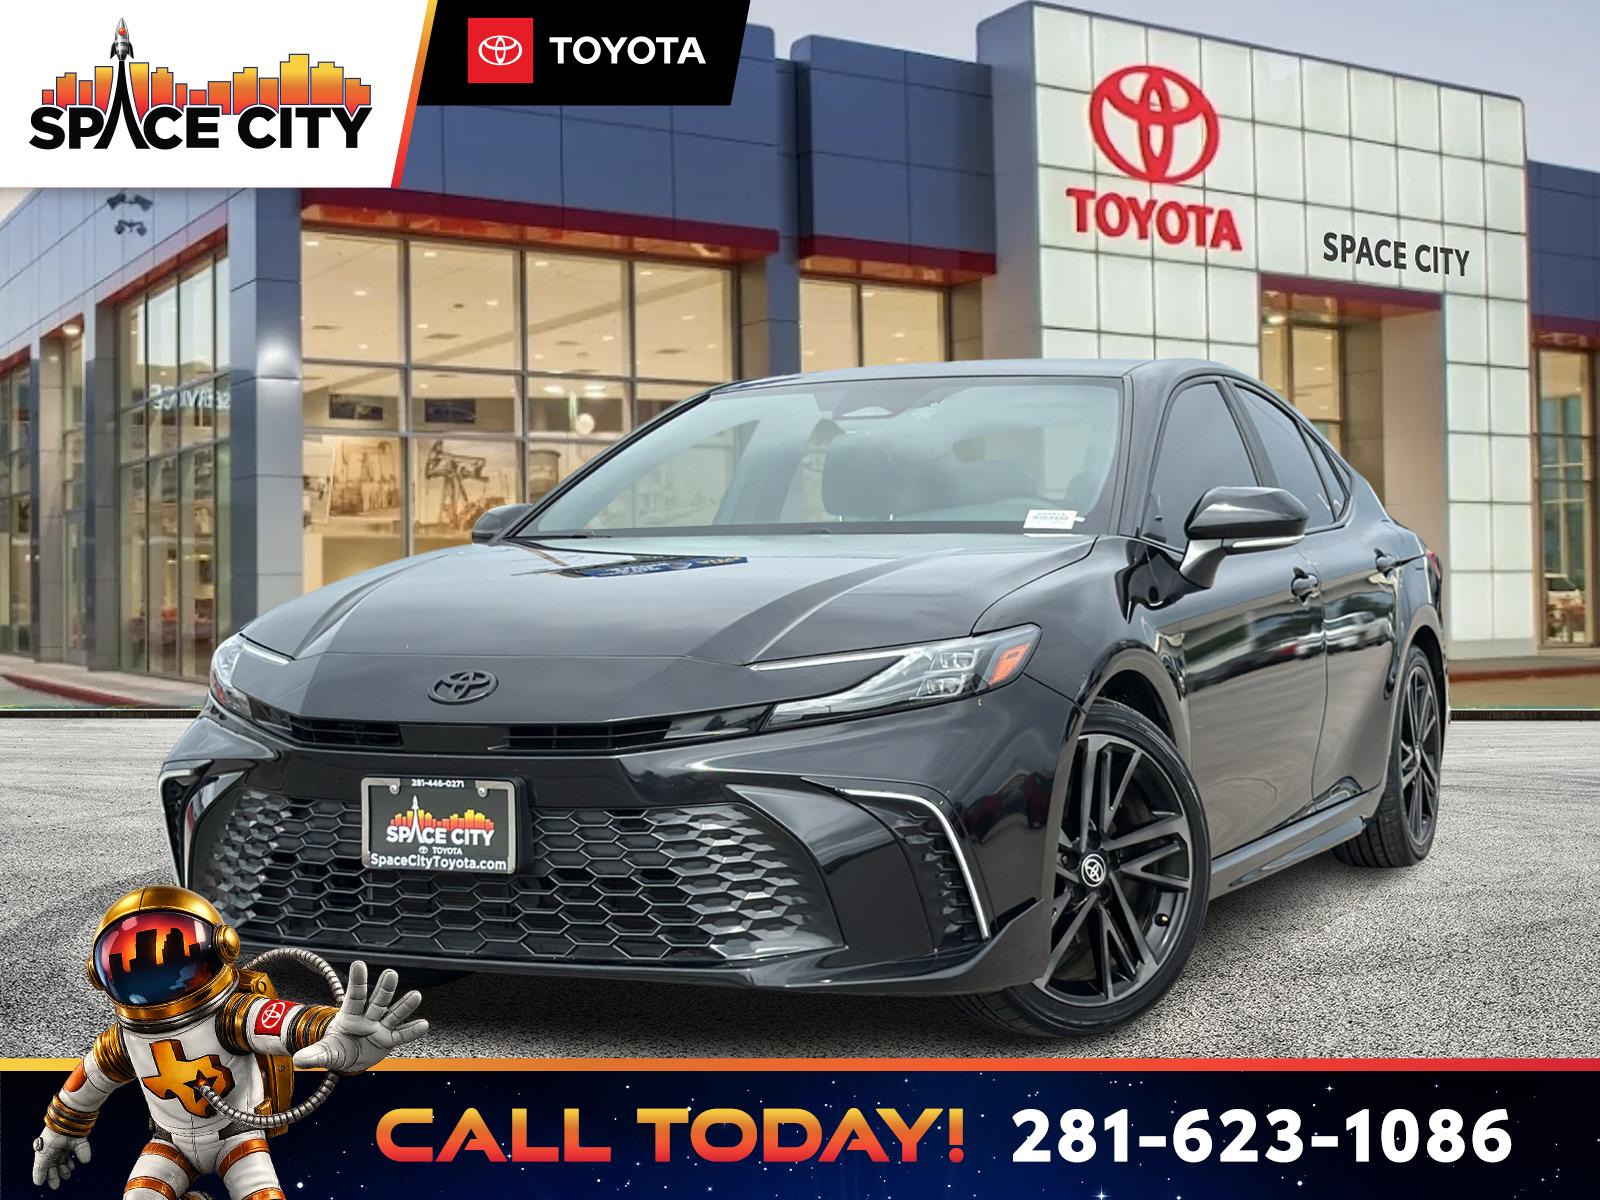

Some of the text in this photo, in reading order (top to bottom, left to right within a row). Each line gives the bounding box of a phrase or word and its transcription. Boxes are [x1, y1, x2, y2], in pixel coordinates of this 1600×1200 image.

[1067, 187, 1242, 251] TOYOTA
[1323, 231, 1471, 278] SPACE CITY
[411, 778, 465, 789] 281-446-0271
[386, 817, 496, 847] SPACE CITY
[370, 853, 507, 871] SpaceCityToyota.com
[431, 846, 463, 856] TOYOTA
